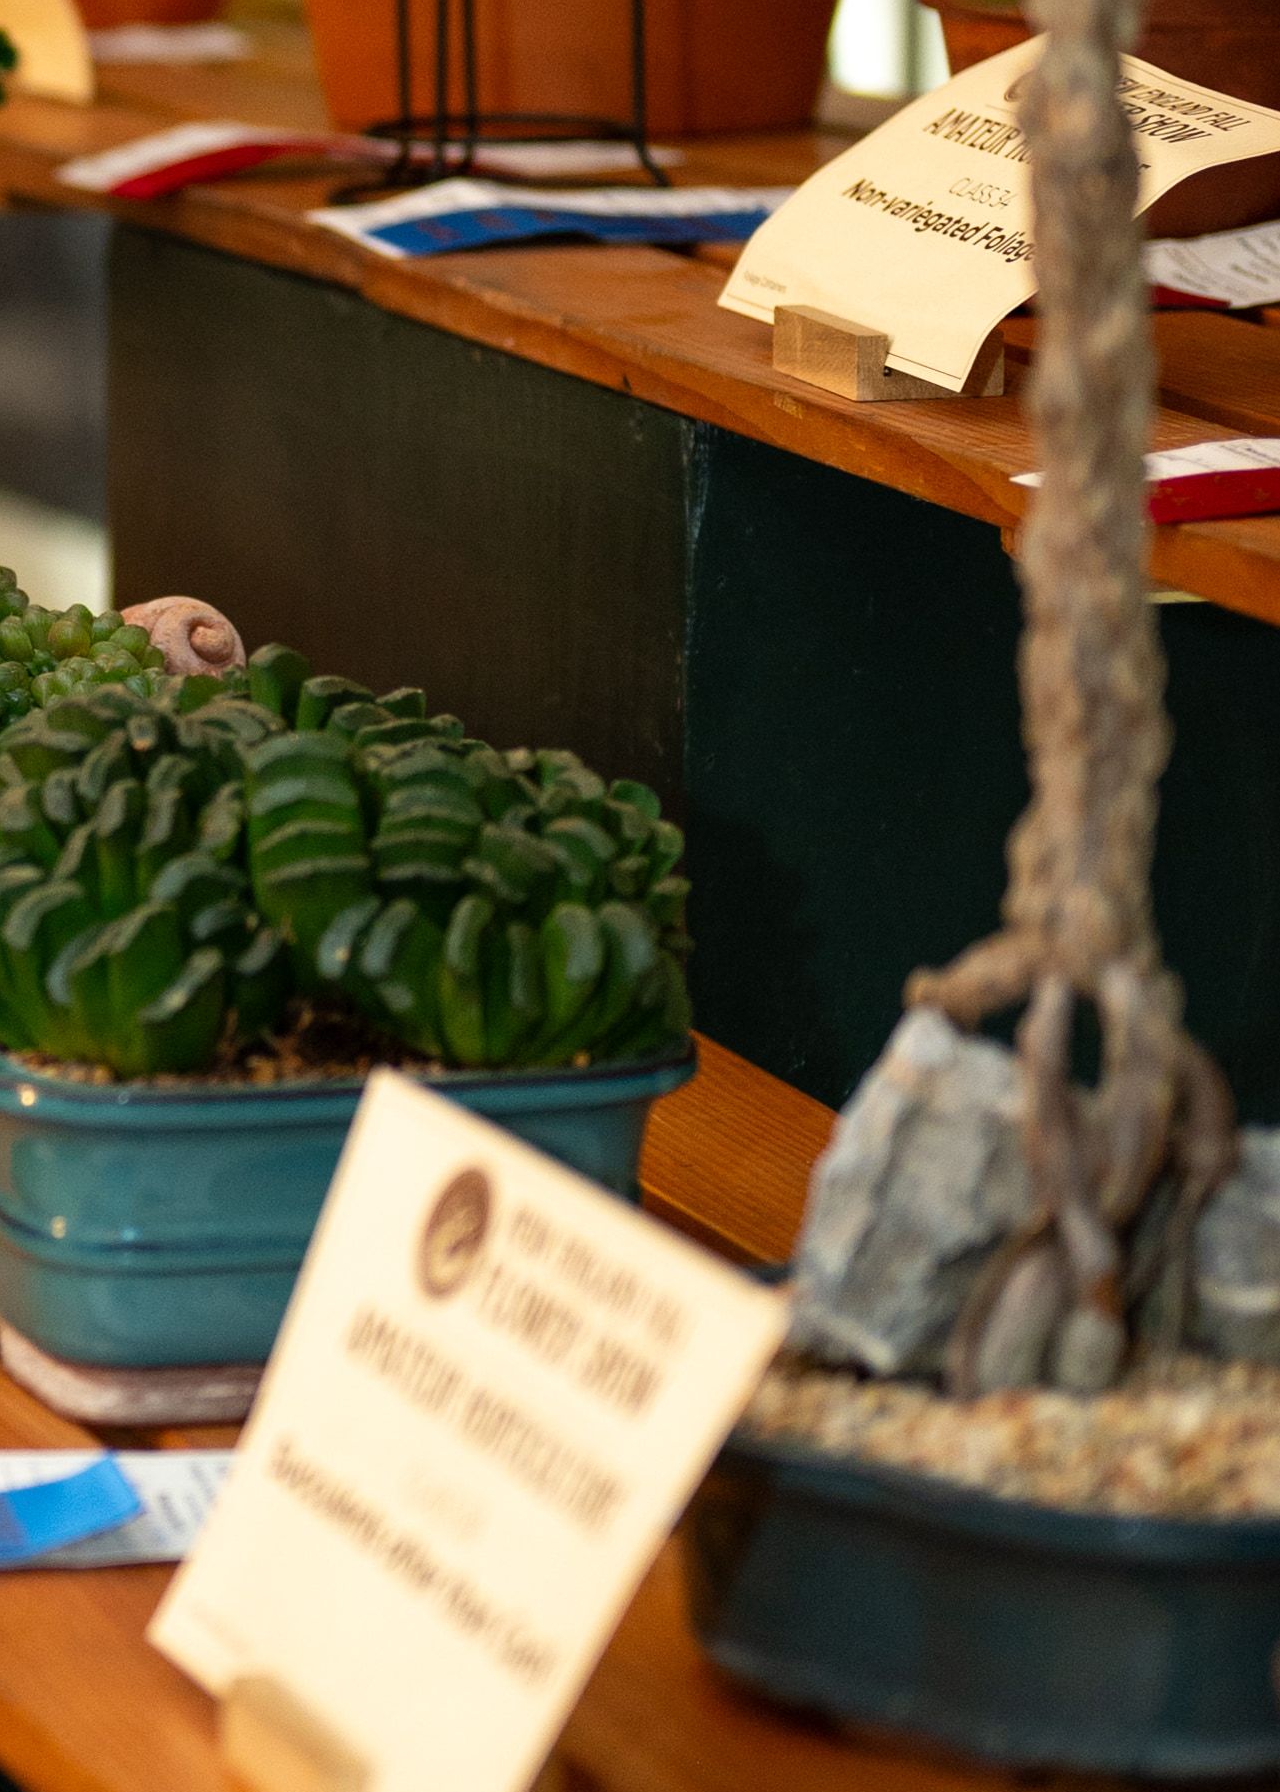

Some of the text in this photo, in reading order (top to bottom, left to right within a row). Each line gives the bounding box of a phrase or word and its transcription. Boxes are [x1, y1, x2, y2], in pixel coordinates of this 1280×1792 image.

[923, 107, 1022, 156] AMATEUR
[1129, 88, 1214, 121] ENGLAND
[1197, 111, 1252, 133] FALL
[1132, 113, 1213, 144] SHOW
[841, 178, 991, 244] Non-variegated
[948, 177, 992, 205] CLASS
